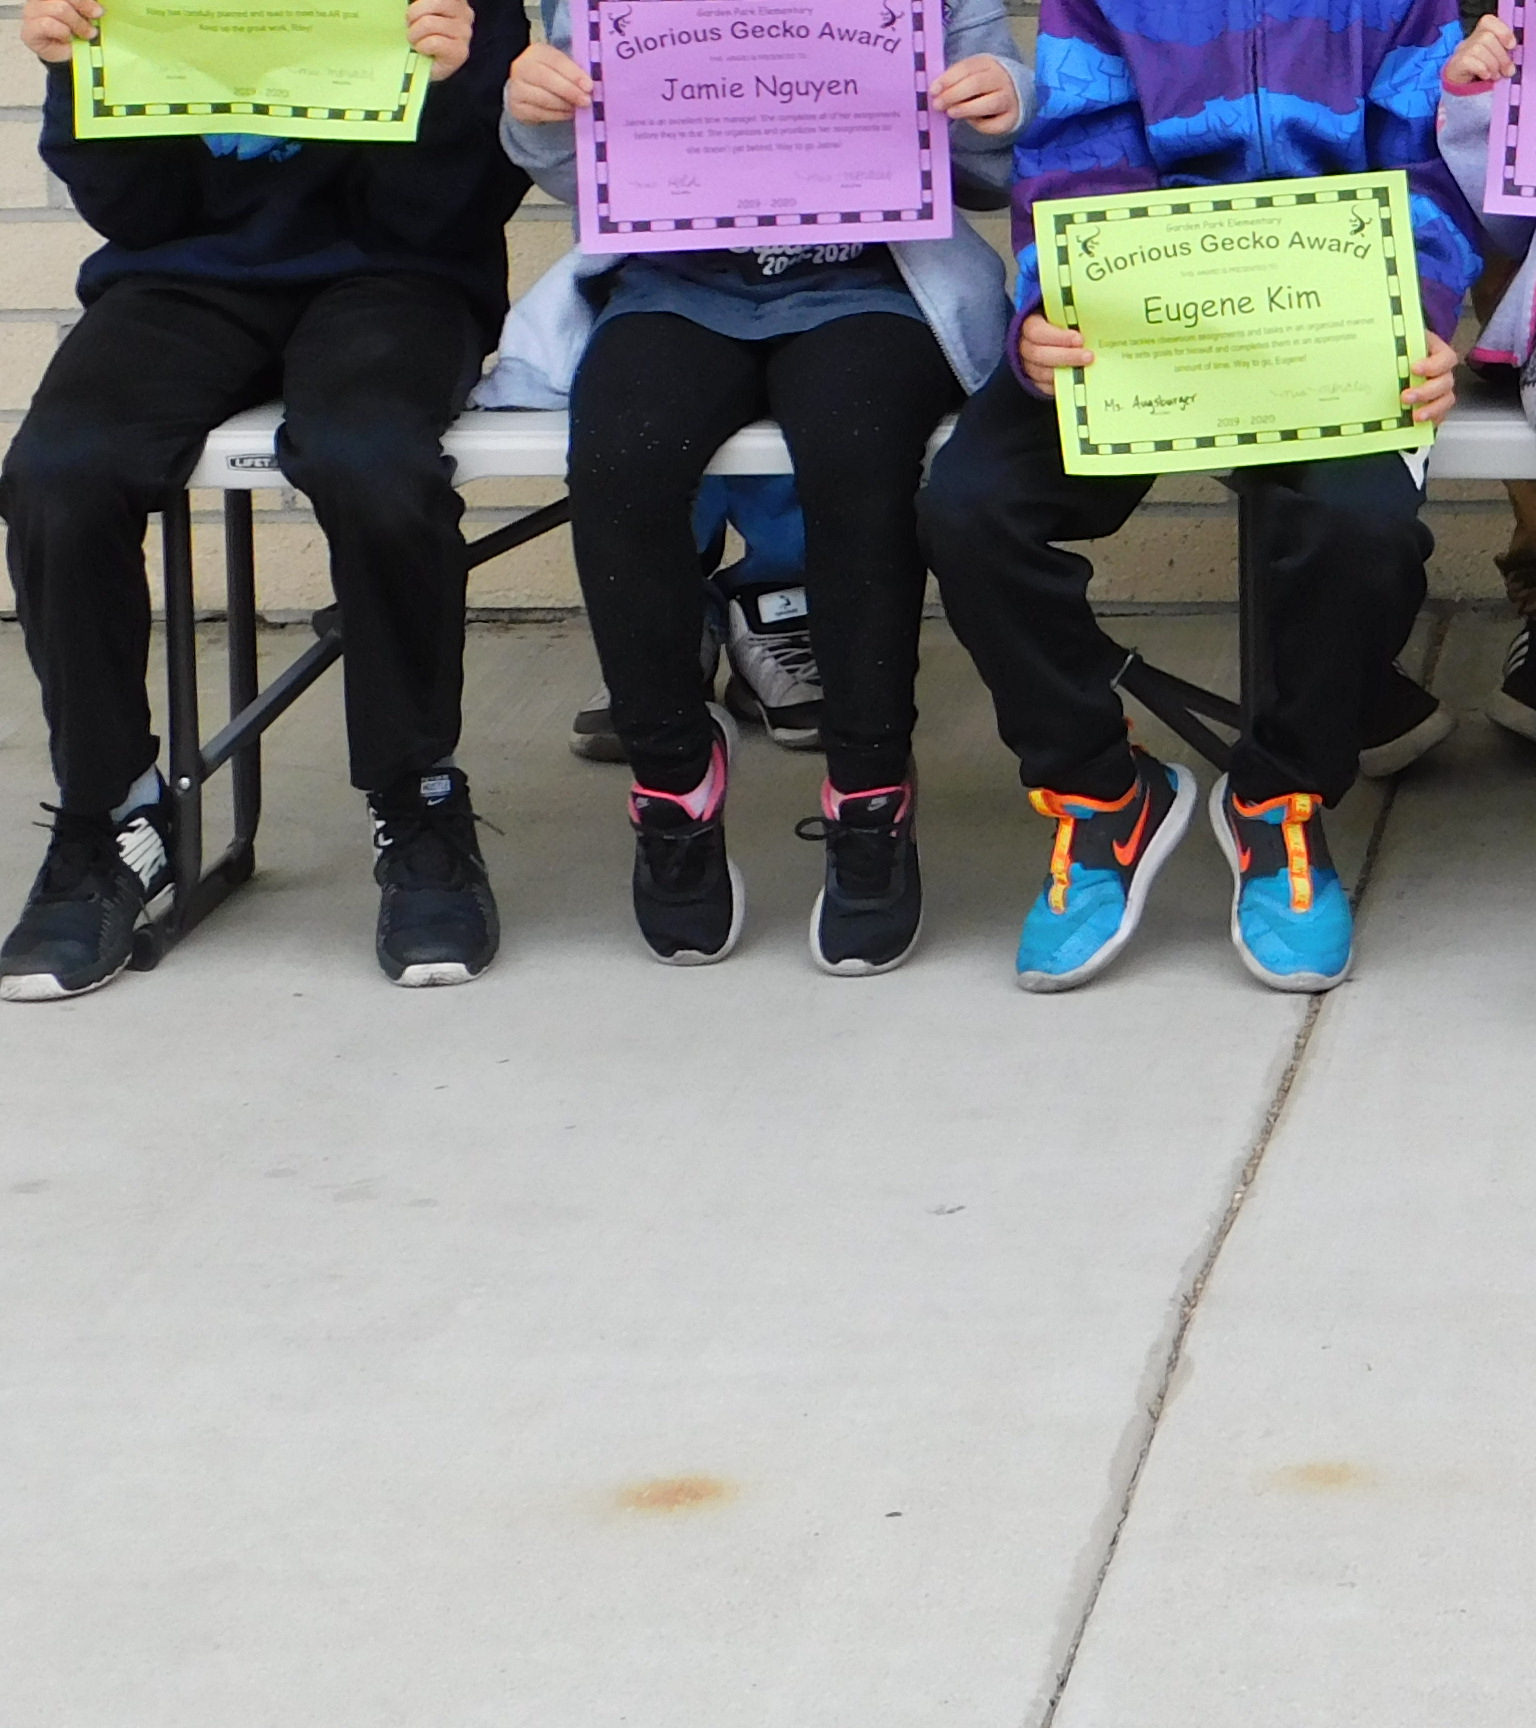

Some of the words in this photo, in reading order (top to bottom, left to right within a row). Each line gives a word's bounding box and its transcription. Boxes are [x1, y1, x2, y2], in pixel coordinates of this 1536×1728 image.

[617, 24, 722, 60] Glorious
[731, 21, 809, 40] Gecko
[818, 22, 901, 54] Award
[662, 78, 744, 101] Jamie
[756, 75, 858, 103] Nguyen
[1166, 222, 1199, 232] Garden
[1203, 220, 1223, 230] Park
[1228, 217, 1282, 229] Elementary
[1086, 241, 1191, 281] Glorious
[1201, 232, 1279, 253] Gecko
[1288, 231, 1371, 260] Award
[1145, 294, 1254, 328] Eugene
[1267, 286, 1321, 313] Kim
